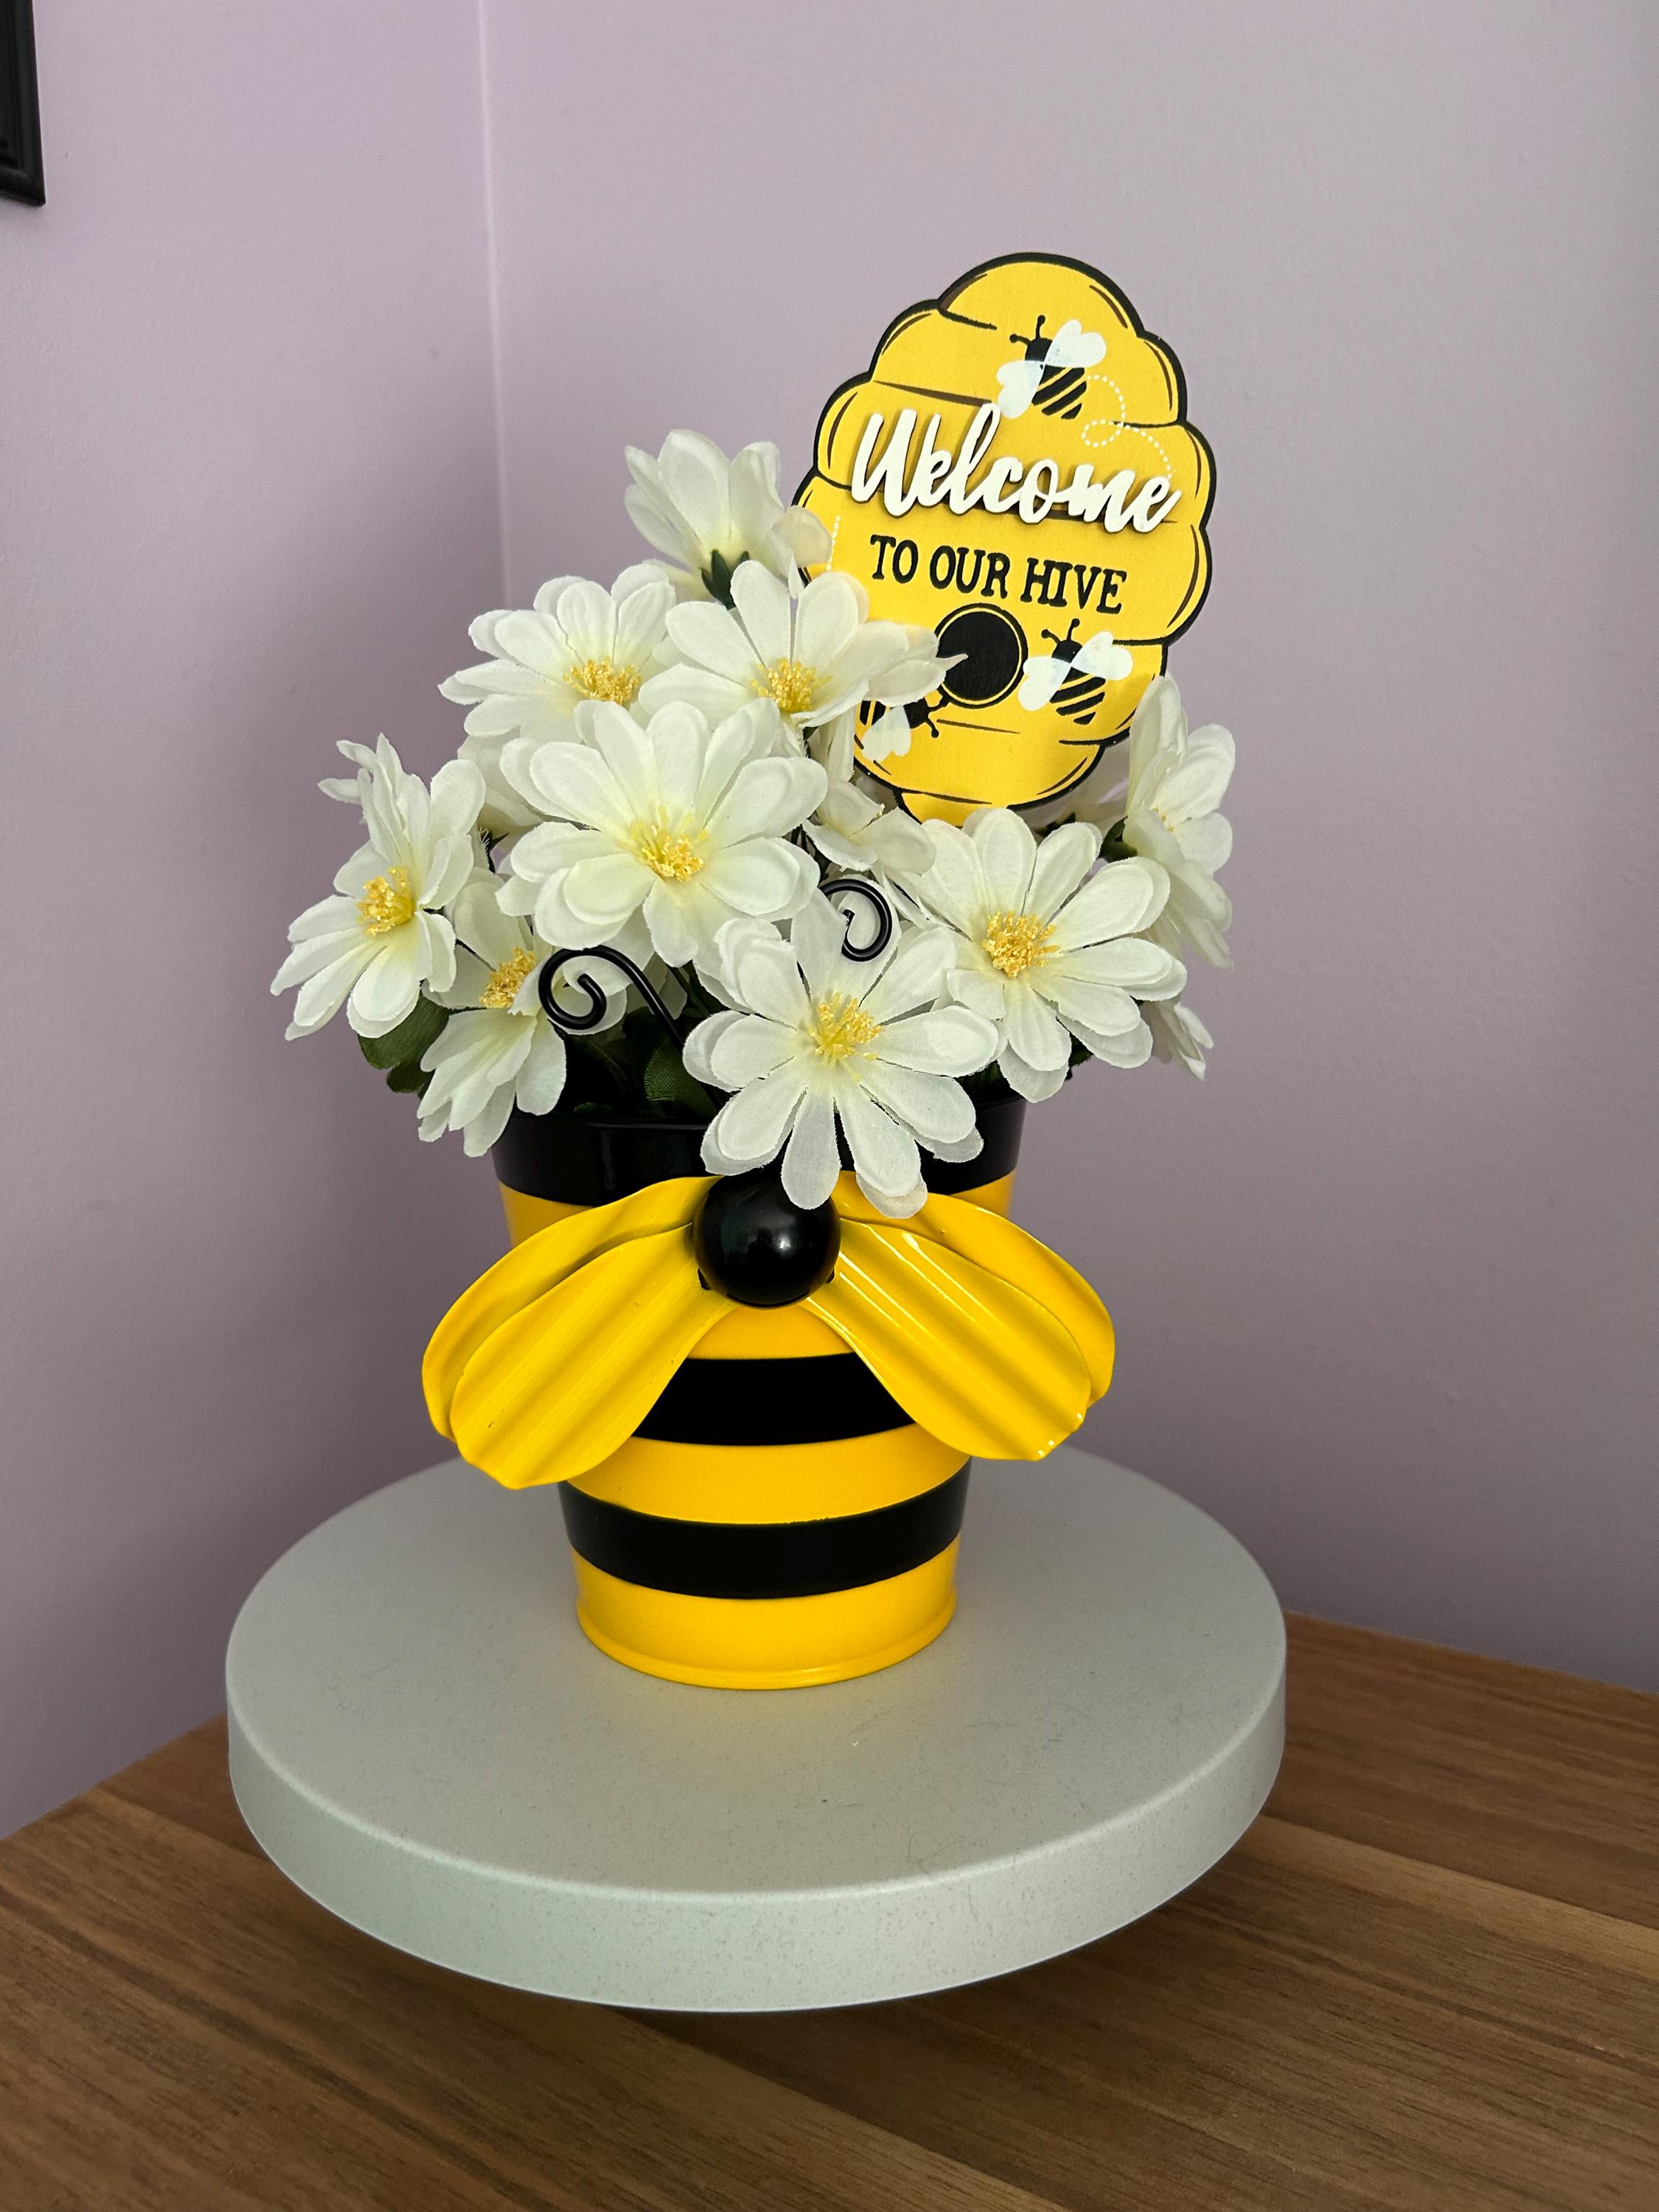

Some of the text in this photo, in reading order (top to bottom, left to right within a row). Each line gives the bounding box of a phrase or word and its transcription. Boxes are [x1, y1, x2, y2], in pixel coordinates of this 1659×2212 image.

[851, 402, 1182, 535] Welcome
[869, 535, 1128, 615] TO OUR HIVE
